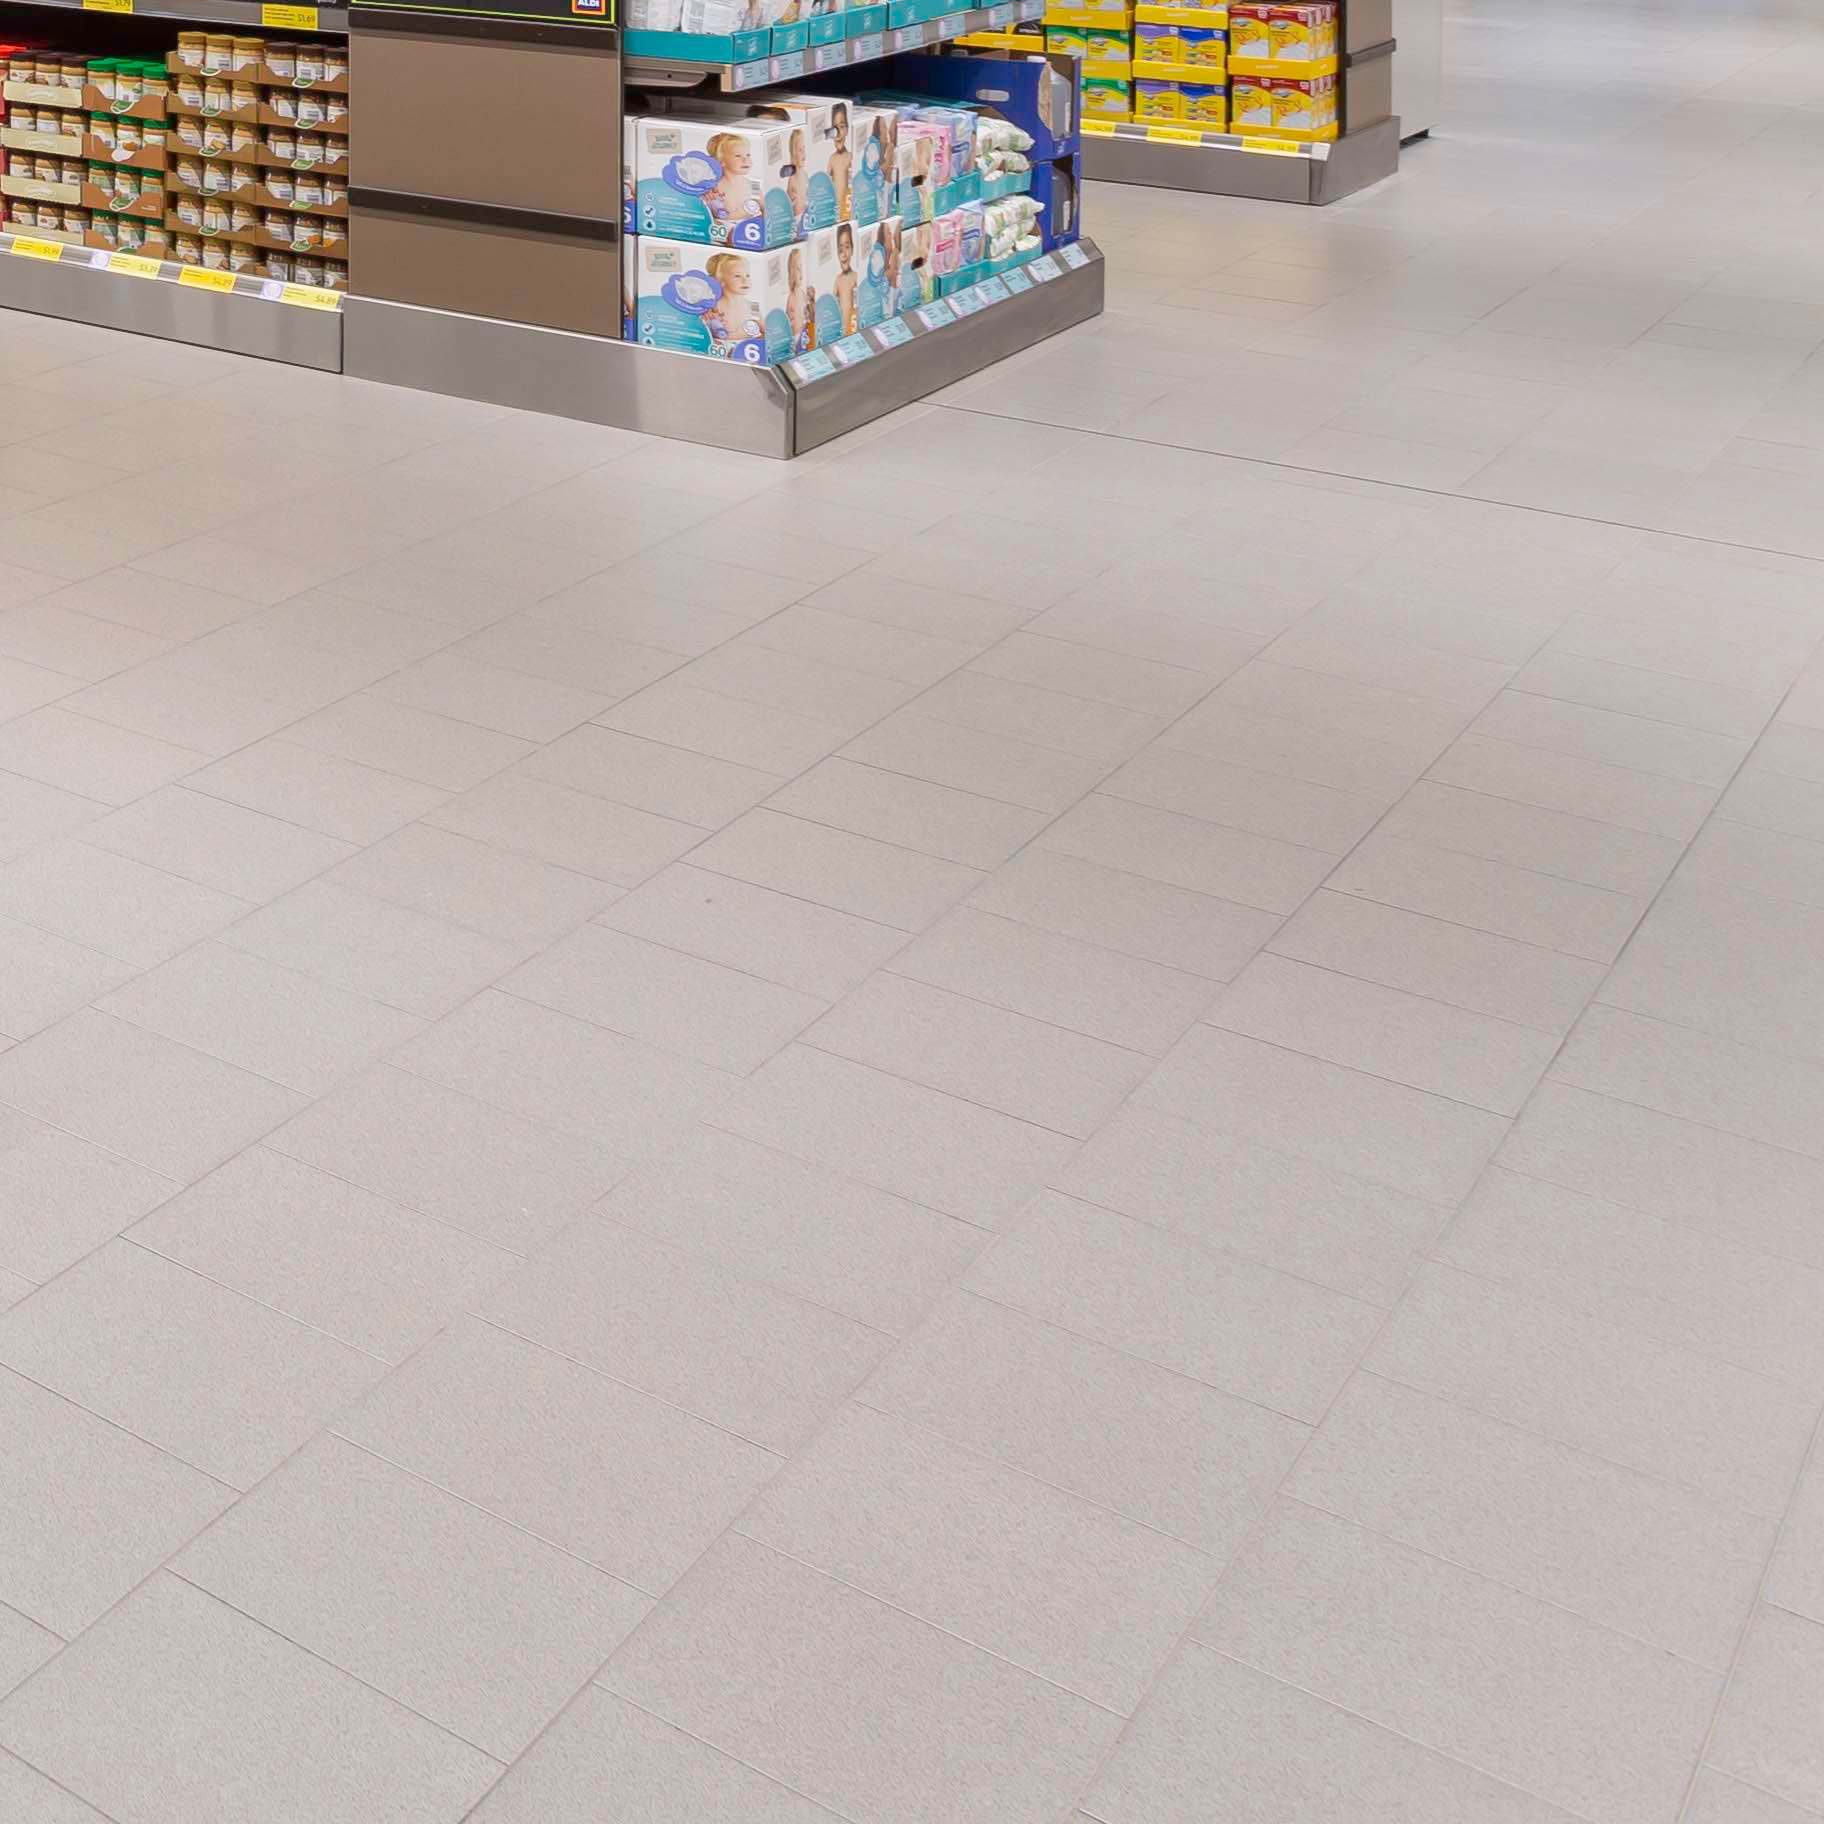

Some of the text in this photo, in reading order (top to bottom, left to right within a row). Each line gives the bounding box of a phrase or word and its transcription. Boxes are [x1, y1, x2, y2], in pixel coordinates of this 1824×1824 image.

[710, 227, 727, 238] 60
[744, 223, 761, 242] 6
[744, 345, 761, 363] 6
